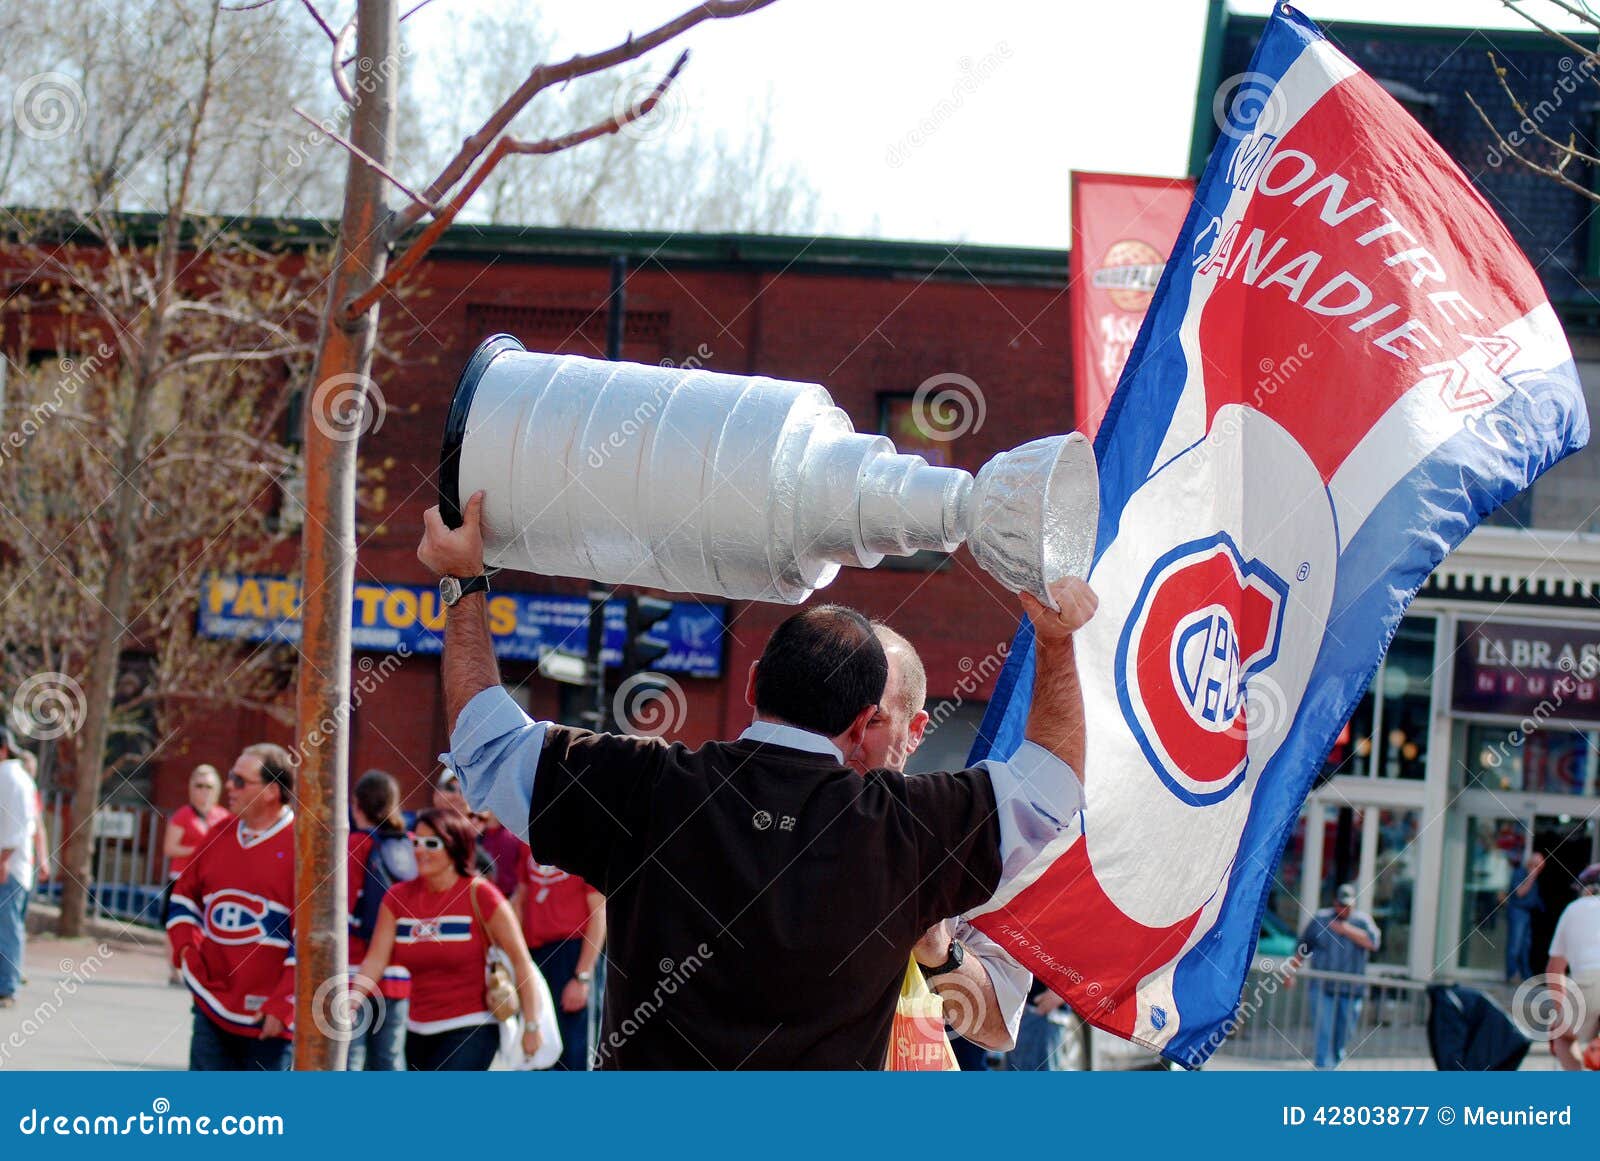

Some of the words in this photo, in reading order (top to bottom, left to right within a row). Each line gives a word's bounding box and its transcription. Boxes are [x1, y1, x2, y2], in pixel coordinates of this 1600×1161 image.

[1192, 216, 1527, 451] CANADIENS
[1225, 132, 1548, 405] MONTREAL
[207, 576, 303, 619] PAR
[354, 586, 517, 636] TOUS
